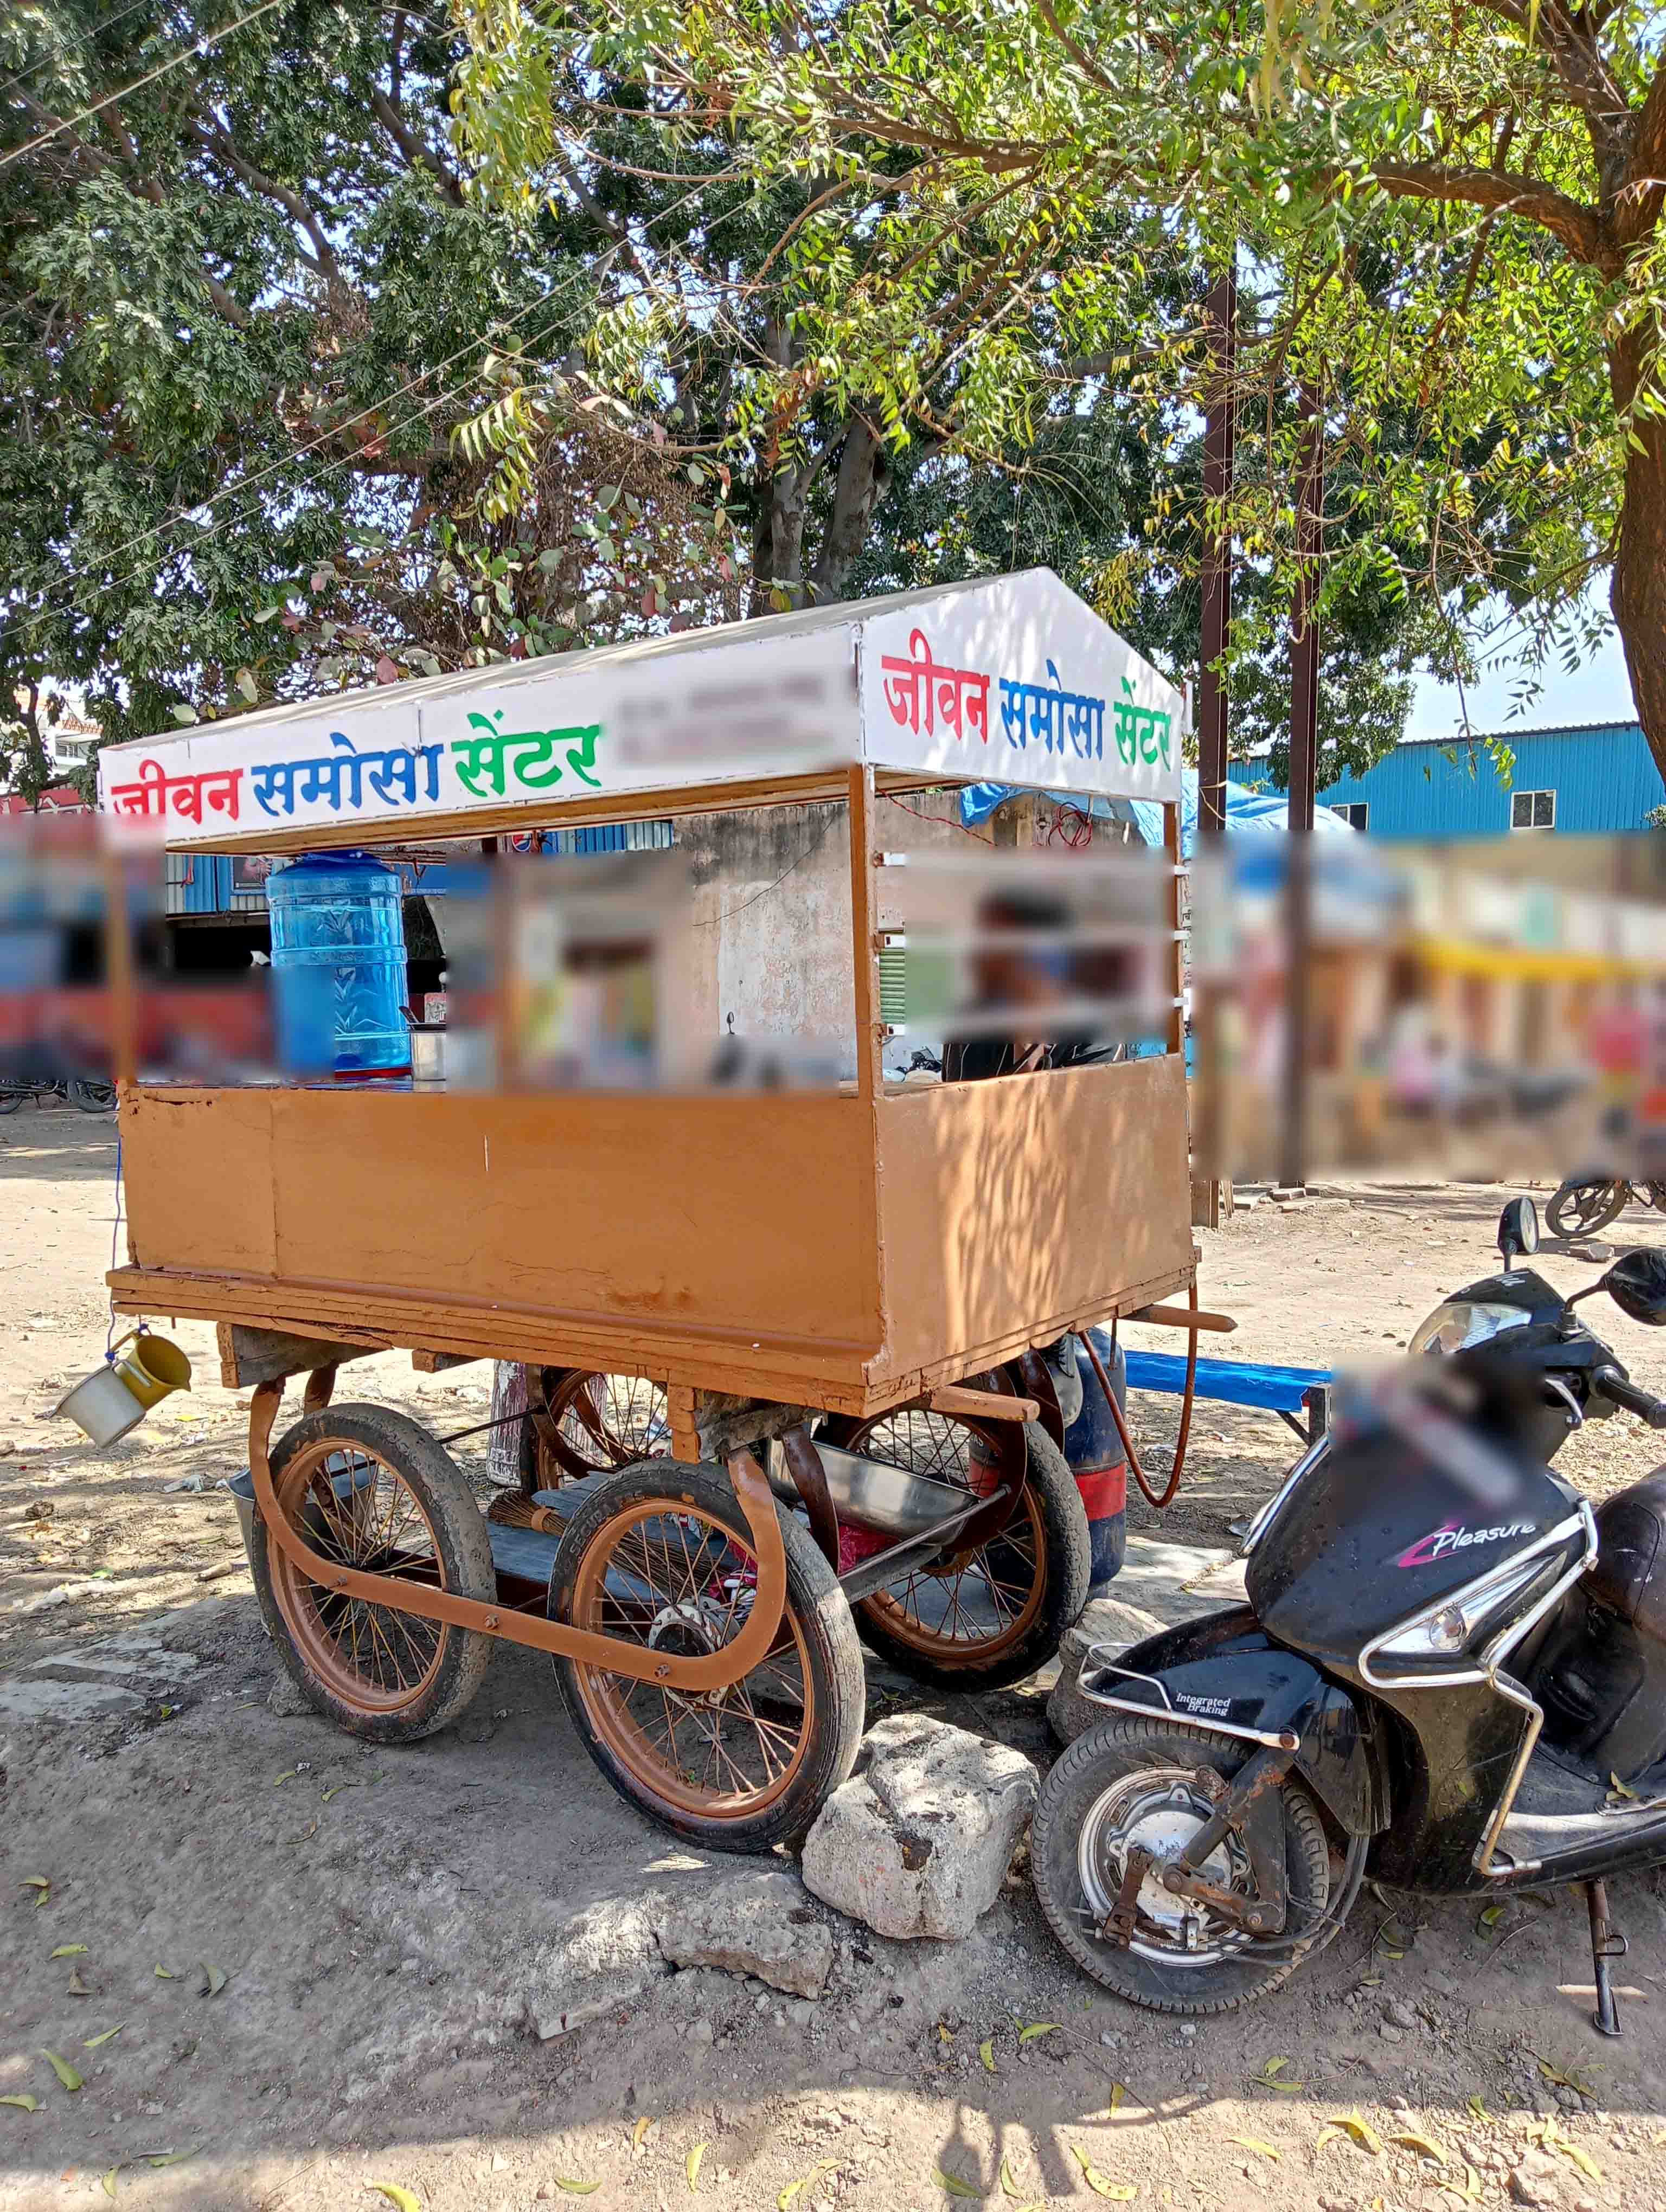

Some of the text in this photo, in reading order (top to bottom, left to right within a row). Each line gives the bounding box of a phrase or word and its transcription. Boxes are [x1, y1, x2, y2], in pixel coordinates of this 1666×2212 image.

[881, 628, 990, 744] जीवन
[999, 658, 1105, 761] समोसा
[1112, 676, 1172, 772] सेंटर
[111, 758, 244, 826] जीवन
[251, 731, 445, 816] समोसा
[451, 710, 603, 799] सेंटर
[1432, 1522, 1537, 1557] Pleasure
[1175, 1692, 1231, 1708] Integrated
[1186, 1702, 1229, 1716] Braking
